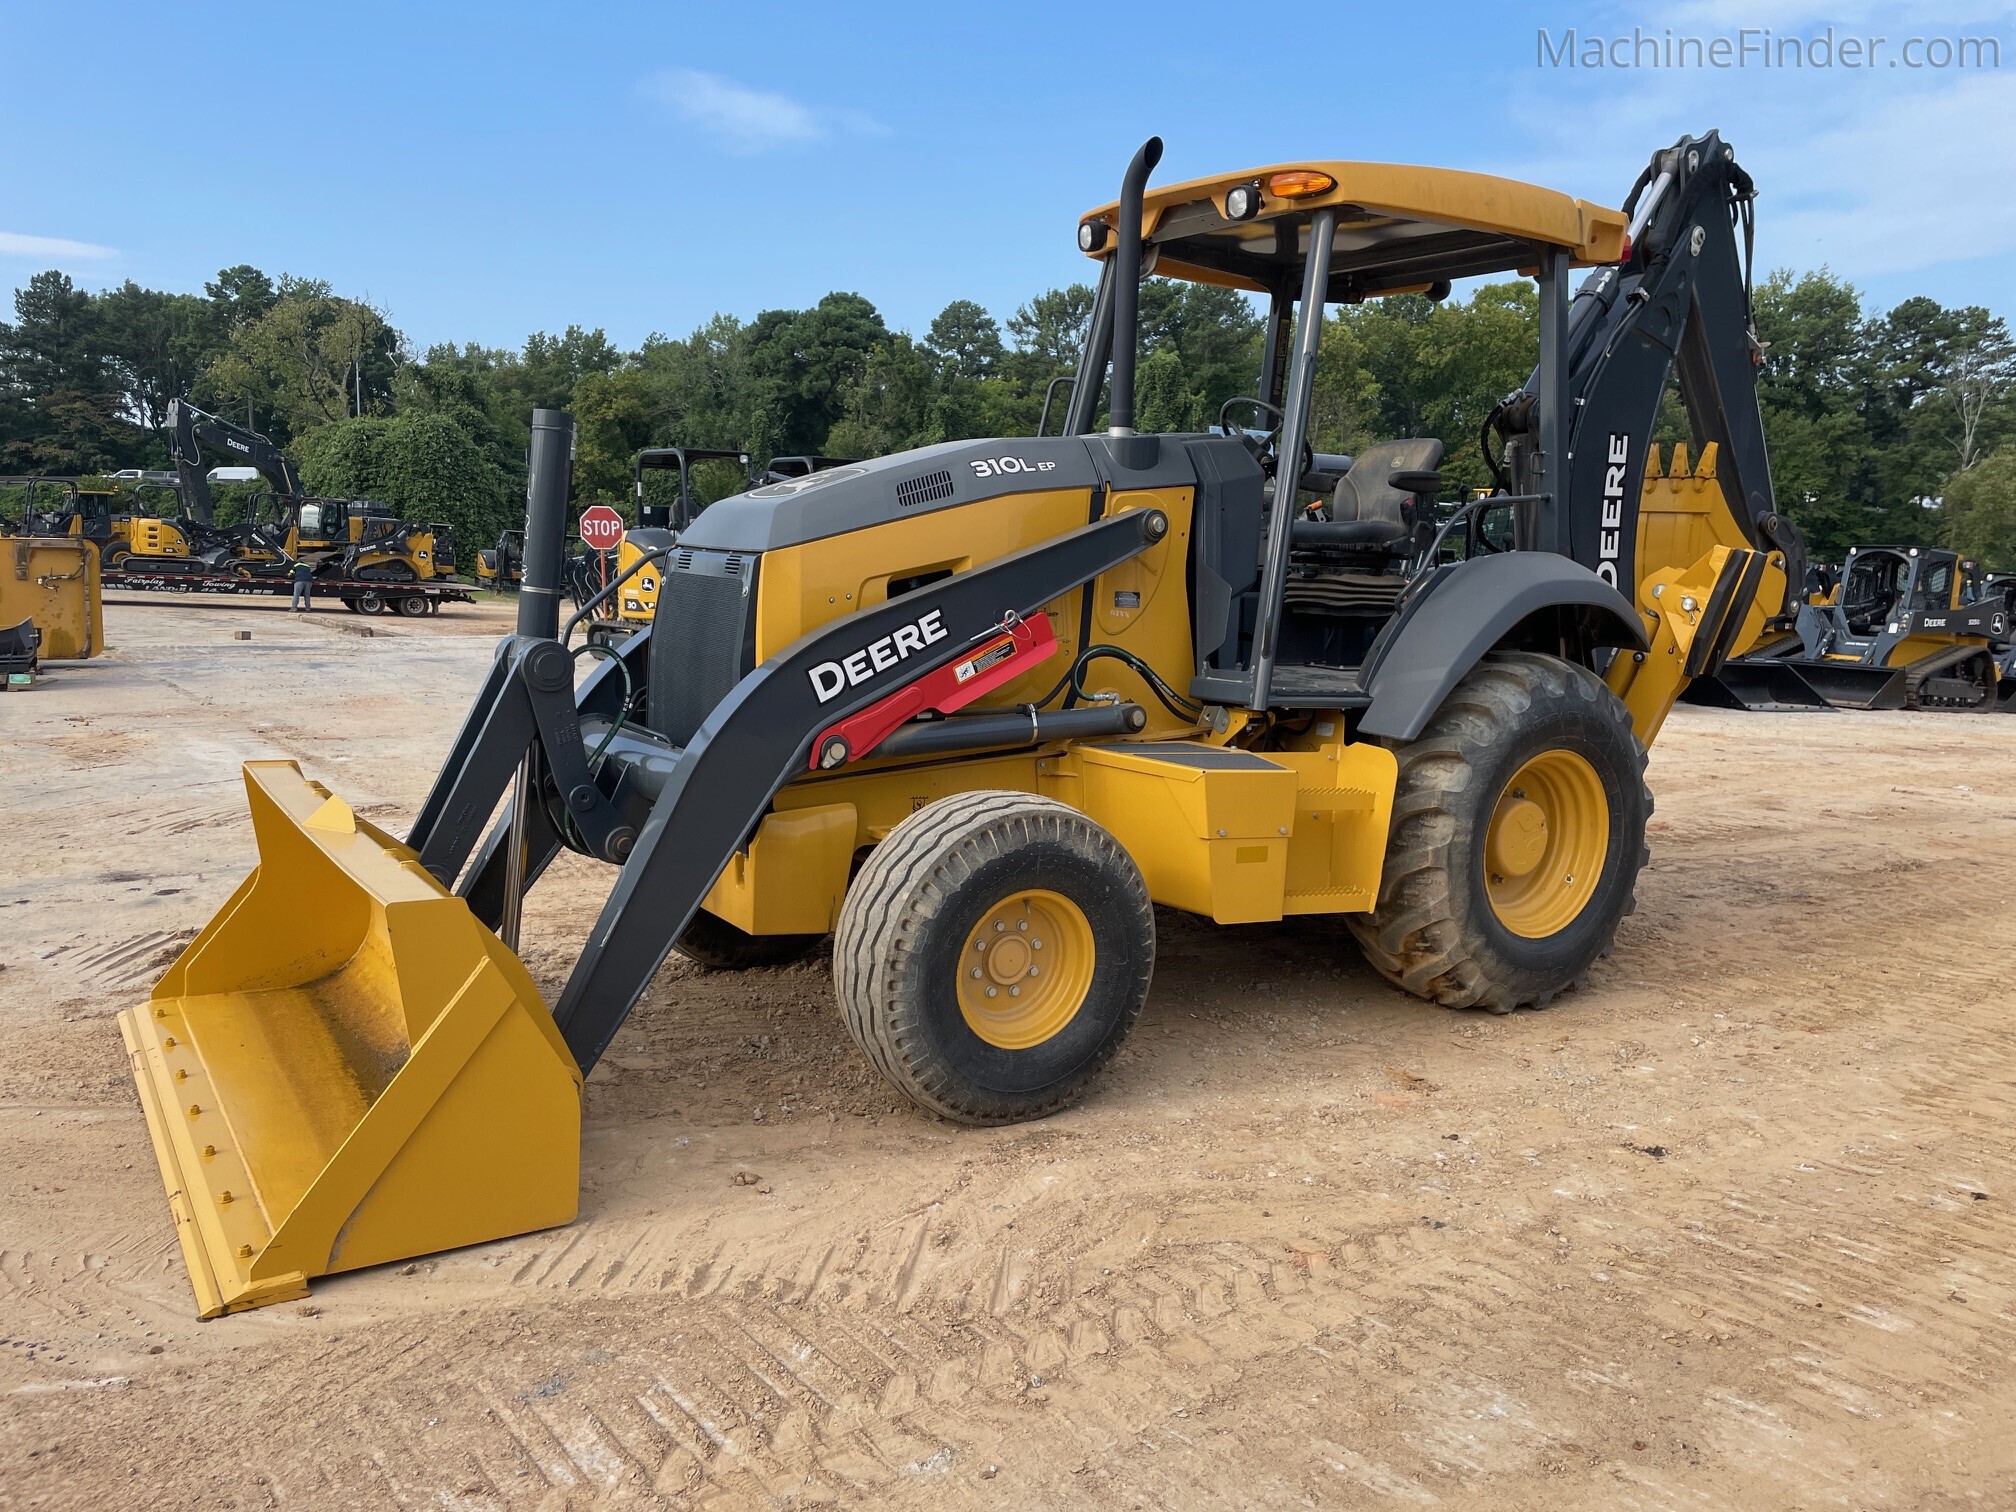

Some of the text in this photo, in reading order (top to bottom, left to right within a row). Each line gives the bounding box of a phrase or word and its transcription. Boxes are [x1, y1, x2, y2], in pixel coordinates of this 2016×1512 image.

[227, 437, 250, 454] DEERE
[970, 456, 1056, 478] 310L EP
[583, 519, 620, 536] STOP
[124, 577, 236, 589] Fairplay Towing
[626, 601, 637, 610] 30
[1923, 617, 1946, 628] DEERE
[808, 609, 948, 704] DEERE
